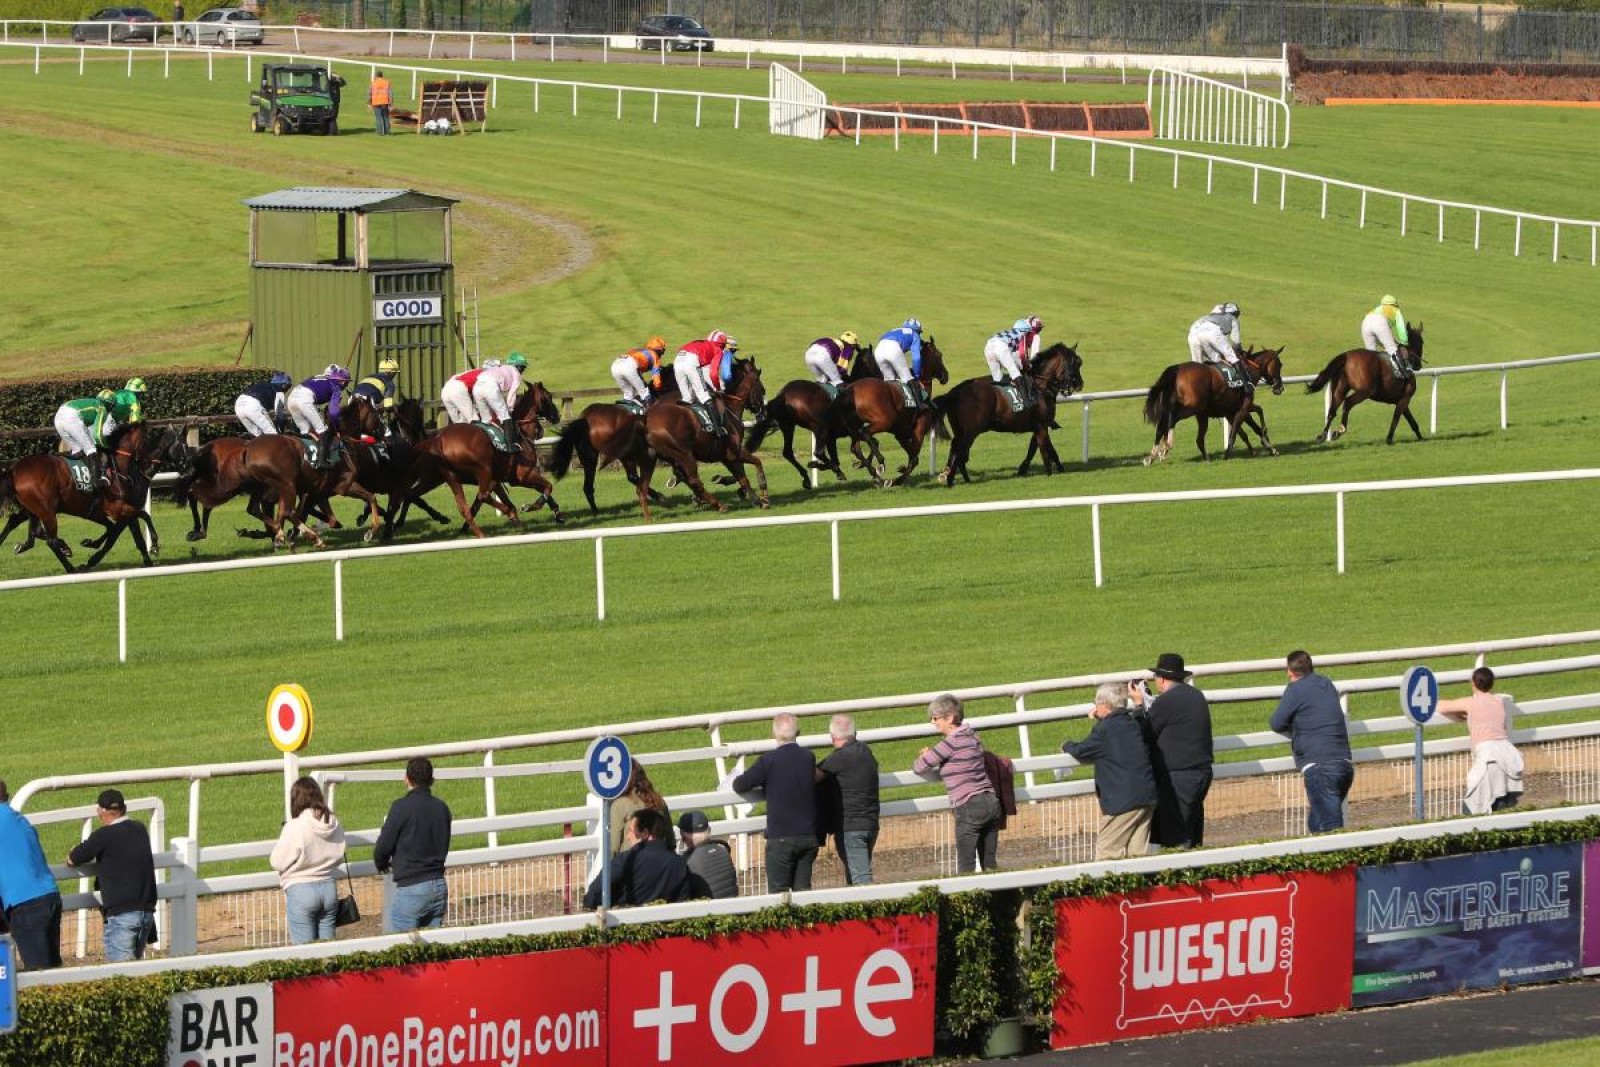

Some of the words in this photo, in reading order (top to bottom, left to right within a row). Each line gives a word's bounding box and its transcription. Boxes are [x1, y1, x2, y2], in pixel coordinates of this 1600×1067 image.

[383, 301, 432, 317] GOOD
[72, 464, 90, 483] 18
[1411, 675, 1432, 714] 4
[598, 746, 622, 789] 3
[1487, 913, 1523, 929] SAFETY
[1528, 907, 1569, 923] SYSTEMS
[1133, 915, 1277, 990] WESCO
[180, 996, 258, 1053] BAR
[633, 949, 913, 1062] tote
[275, 1008, 600, 1067] BarOneRacing.com
